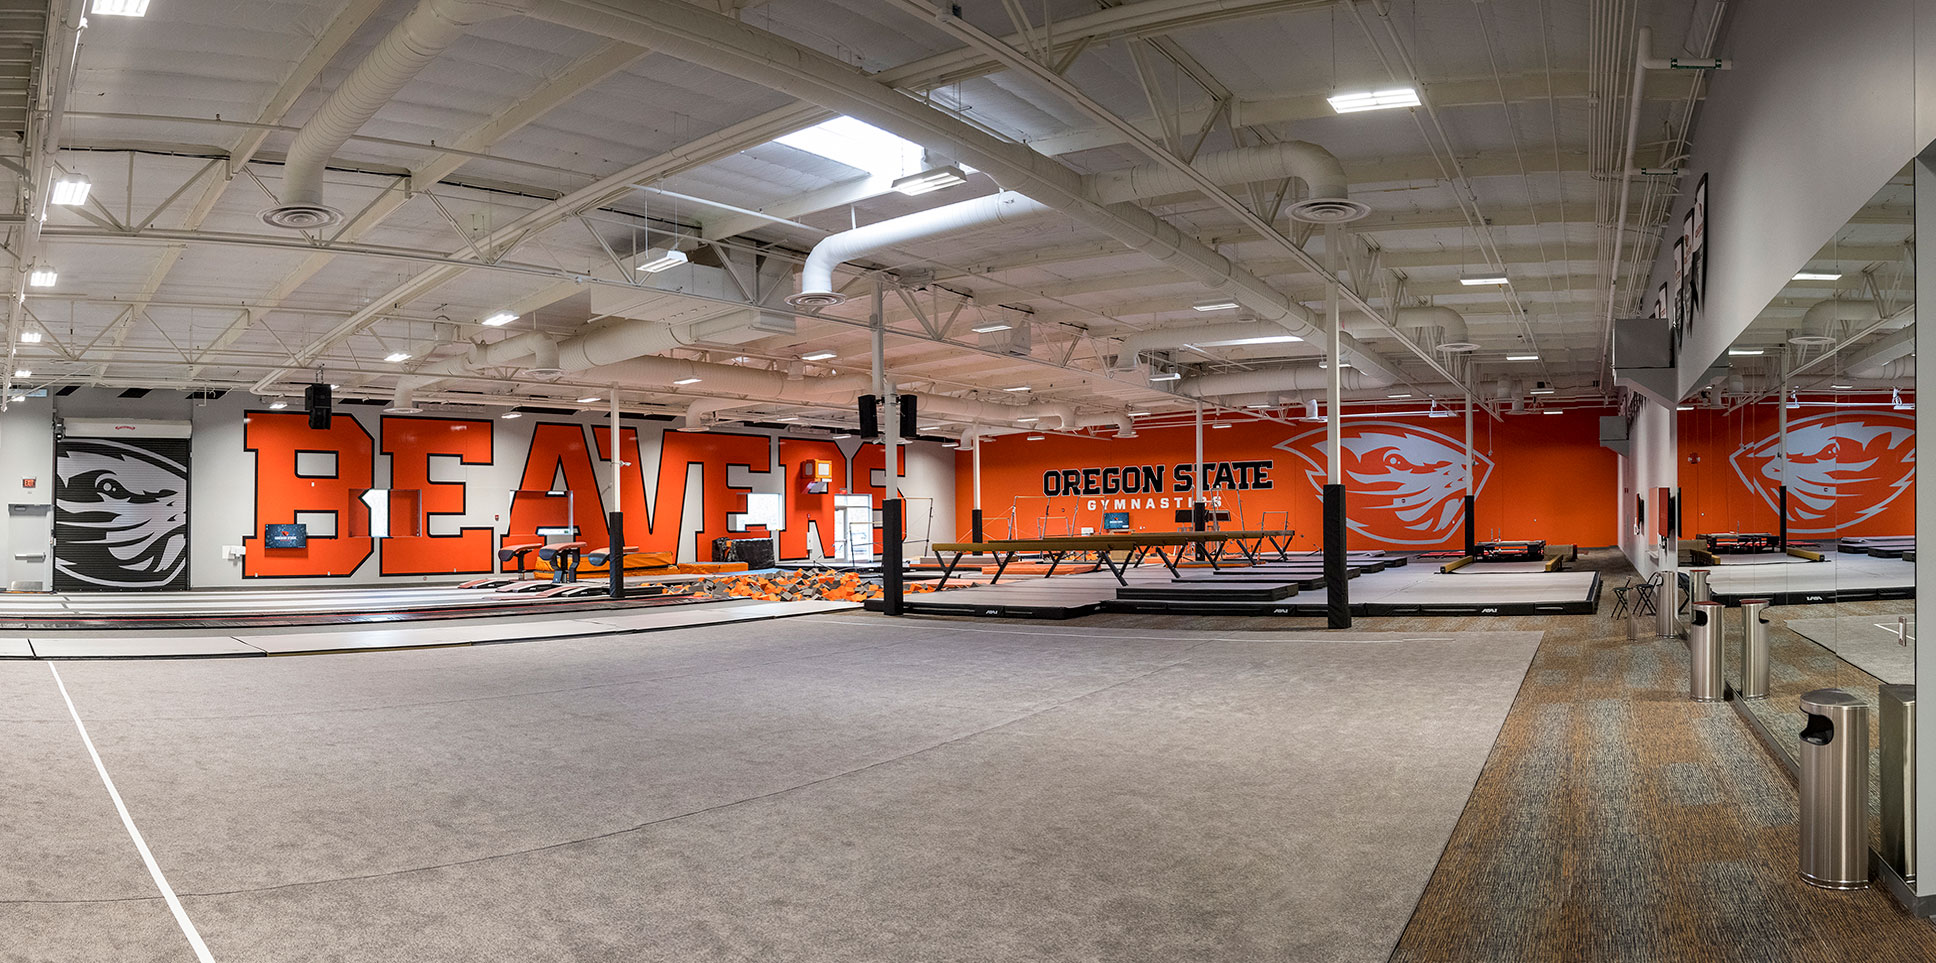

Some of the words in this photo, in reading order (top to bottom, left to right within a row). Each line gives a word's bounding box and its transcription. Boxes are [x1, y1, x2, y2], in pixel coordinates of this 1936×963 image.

[242, 409, 907, 579] BEAVERS
[1043, 464, 1165, 497] OREGON
[1173, 459, 1273, 493] STATE
